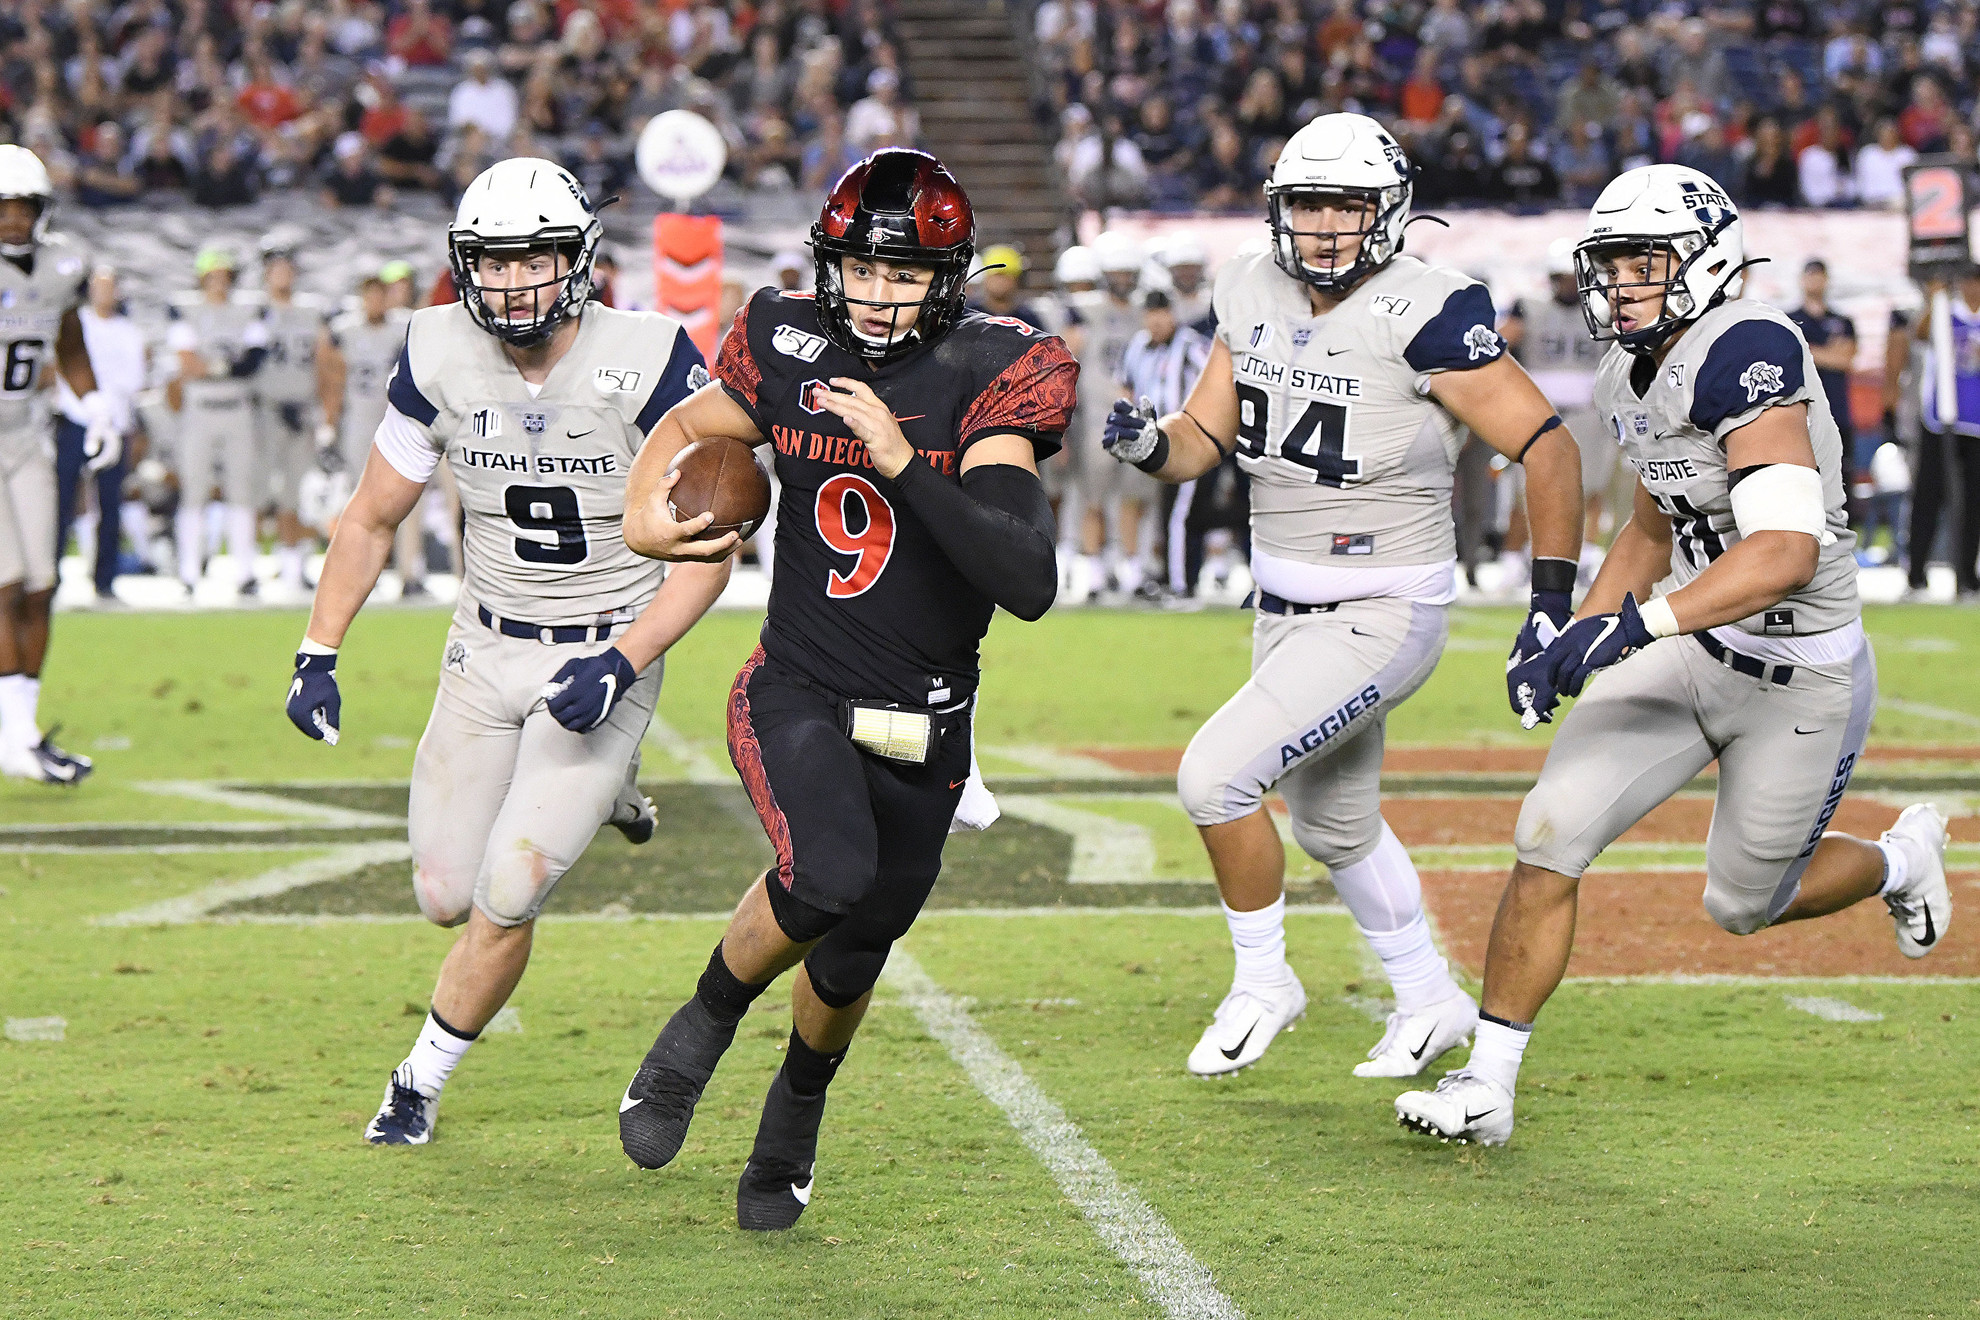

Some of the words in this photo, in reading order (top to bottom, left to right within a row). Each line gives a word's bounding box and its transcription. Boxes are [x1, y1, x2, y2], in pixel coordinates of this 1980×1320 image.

[1910, 167, 1966, 238] 2
[773, 324, 829, 363] 150
[863, 347, 886, 356] Riddell
[4, 339, 44, 391] 6
[595, 367, 643, 392] 150
[1291, 369, 1361, 397] STATE
[772, 424, 804, 458] SAN
[1235, 380, 1360, 490] 94
[462, 447, 527, 472] UTAH
[537, 455, 616, 474] STATE
[1648, 459, 1698, 481] STATE
[504, 484, 588, 564] 9
[814, 473, 897, 599] 9
[1774, 613, 1783, 623] L
[932, 677, 943, 688] M
[1281, 684, 1380, 768] AGGIES
[1800, 752, 1856, 858] AGGIES
